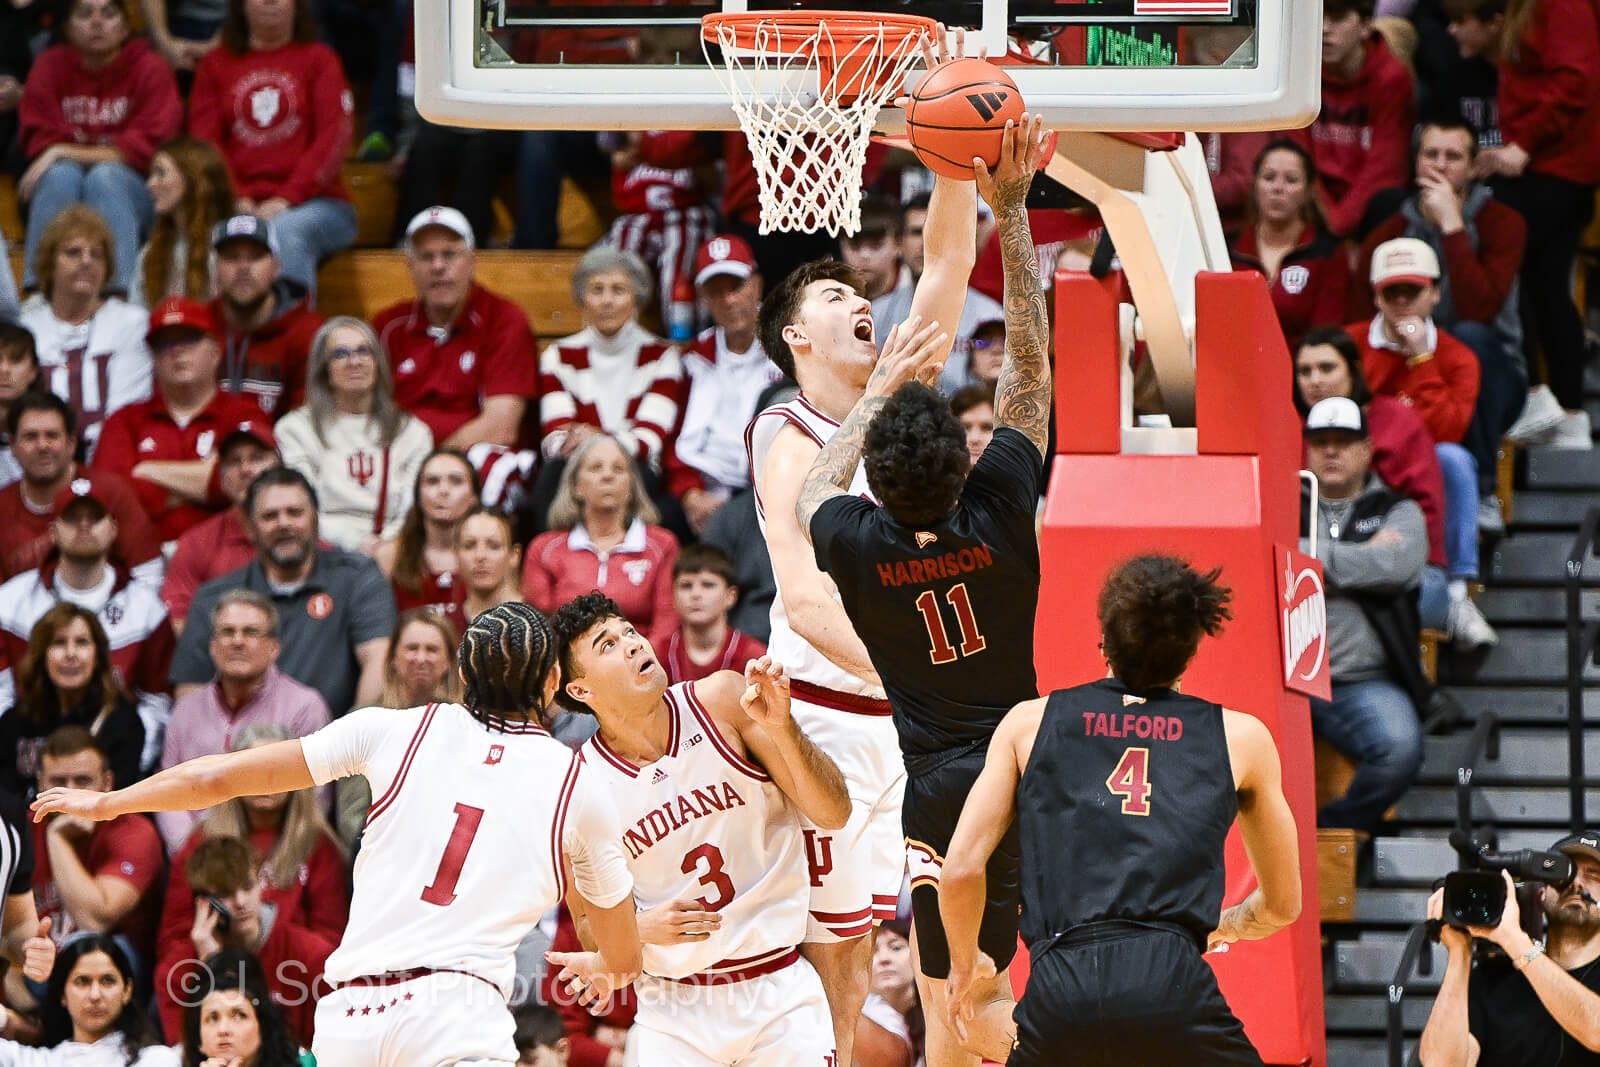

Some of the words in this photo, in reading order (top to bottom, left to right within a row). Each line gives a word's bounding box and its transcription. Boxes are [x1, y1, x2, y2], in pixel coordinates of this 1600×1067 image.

[876, 545, 993, 587] HARRISON
[915, 582, 987, 665] 11
[1082, 711, 1184, 741] TALFORD
[1105, 747, 1152, 816] 4
[420, 802, 485, 906] 1
[622, 781, 746, 860] INDIANA
[680, 843, 736, 913] 3
